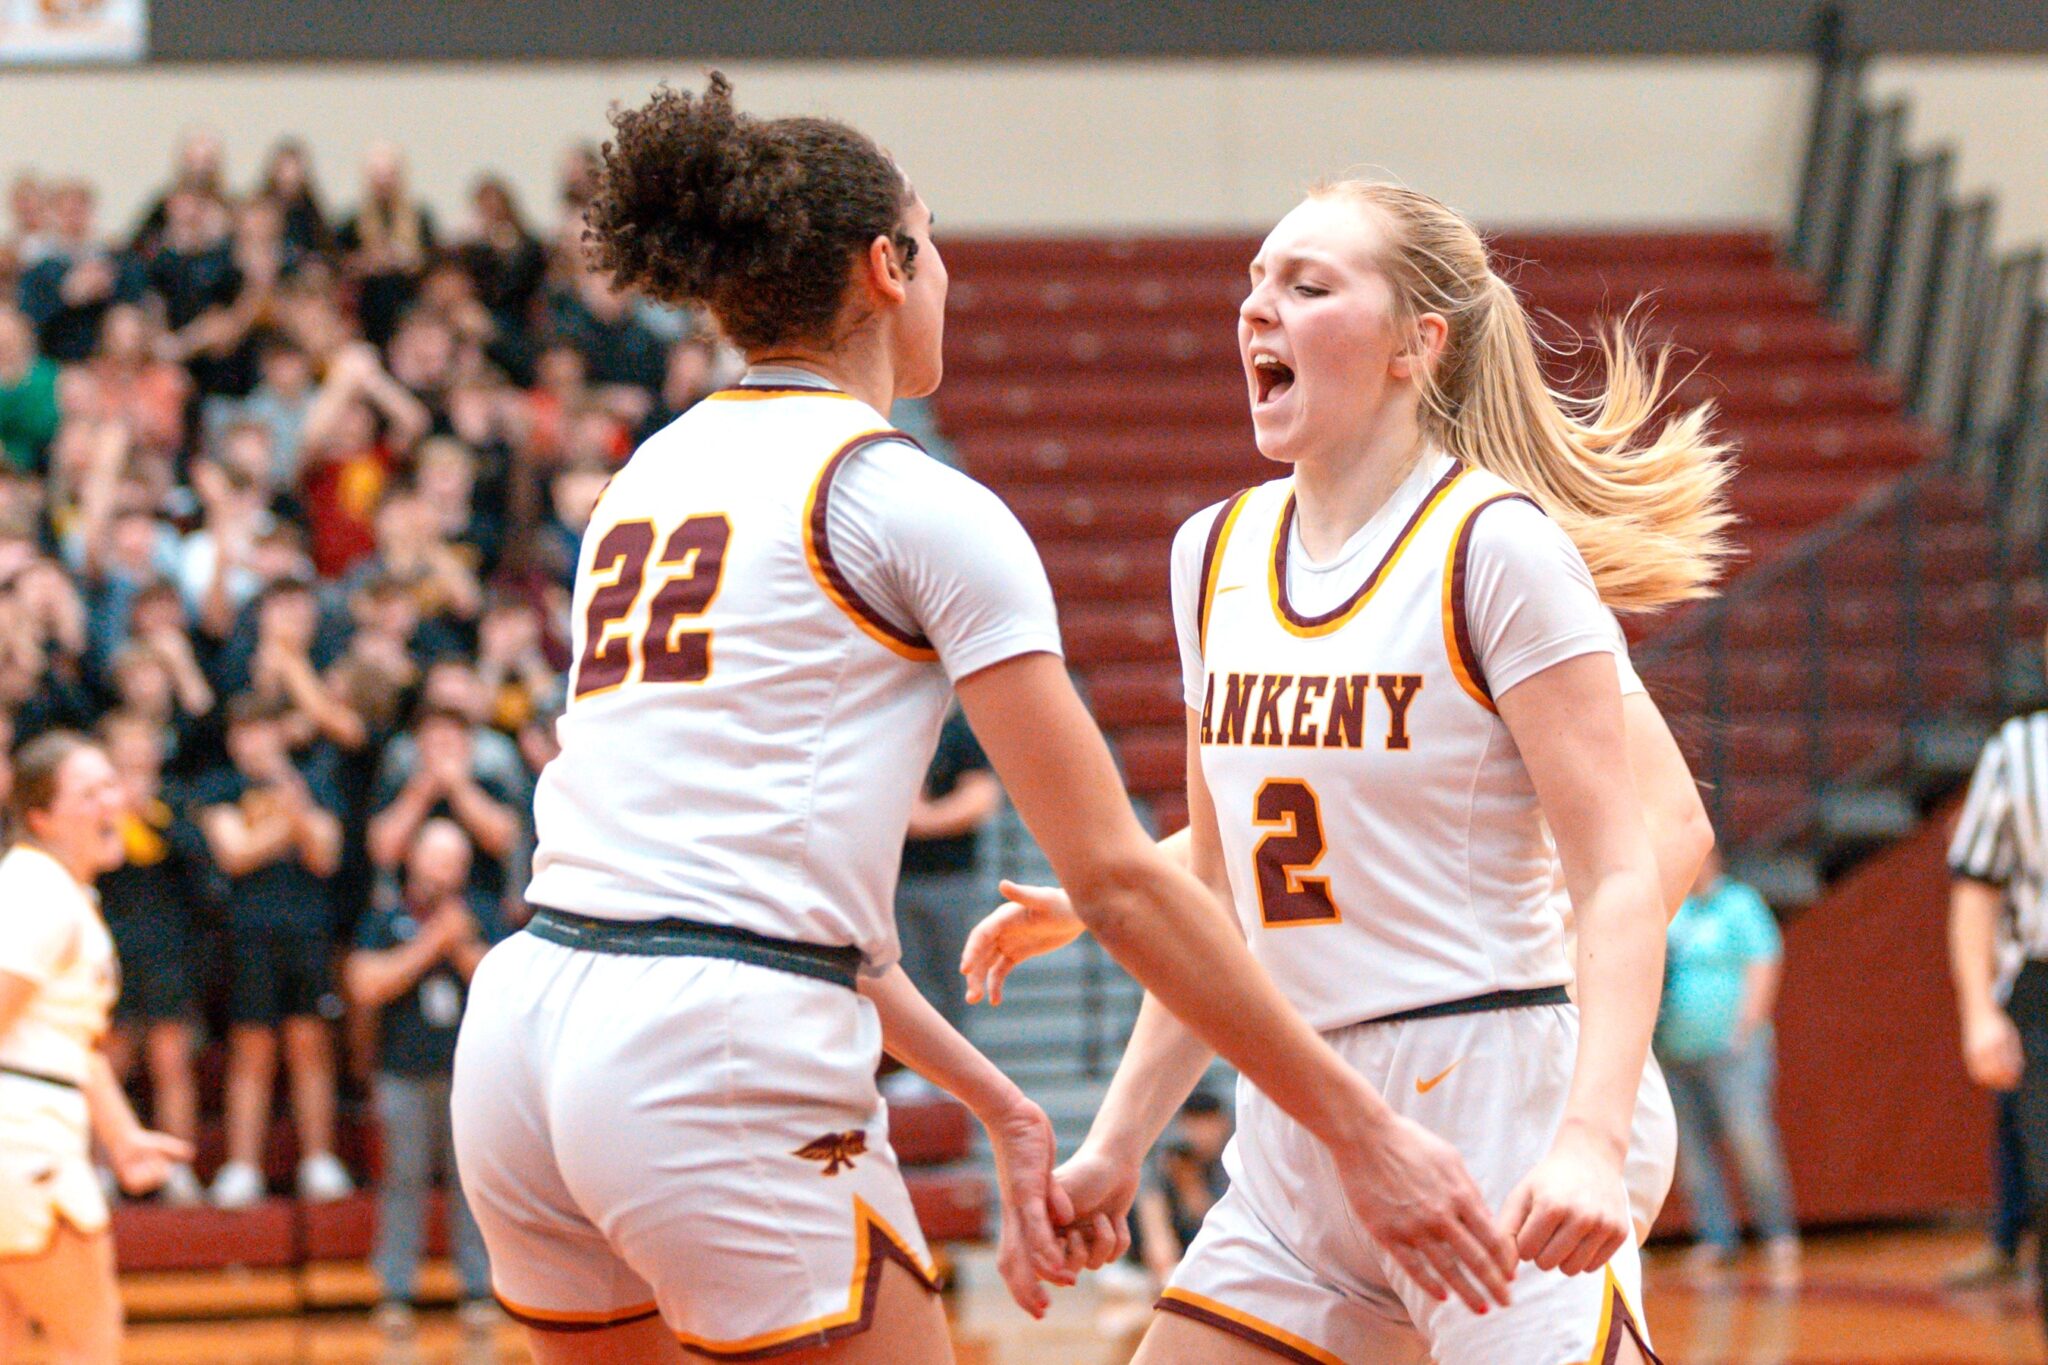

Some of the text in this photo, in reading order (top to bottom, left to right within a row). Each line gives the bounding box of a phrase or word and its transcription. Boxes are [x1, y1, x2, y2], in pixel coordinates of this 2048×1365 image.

[574, 512, 734, 702] 22
[1200, 671, 1424, 750] ANKENY
[1252, 777, 1342, 929] 2
